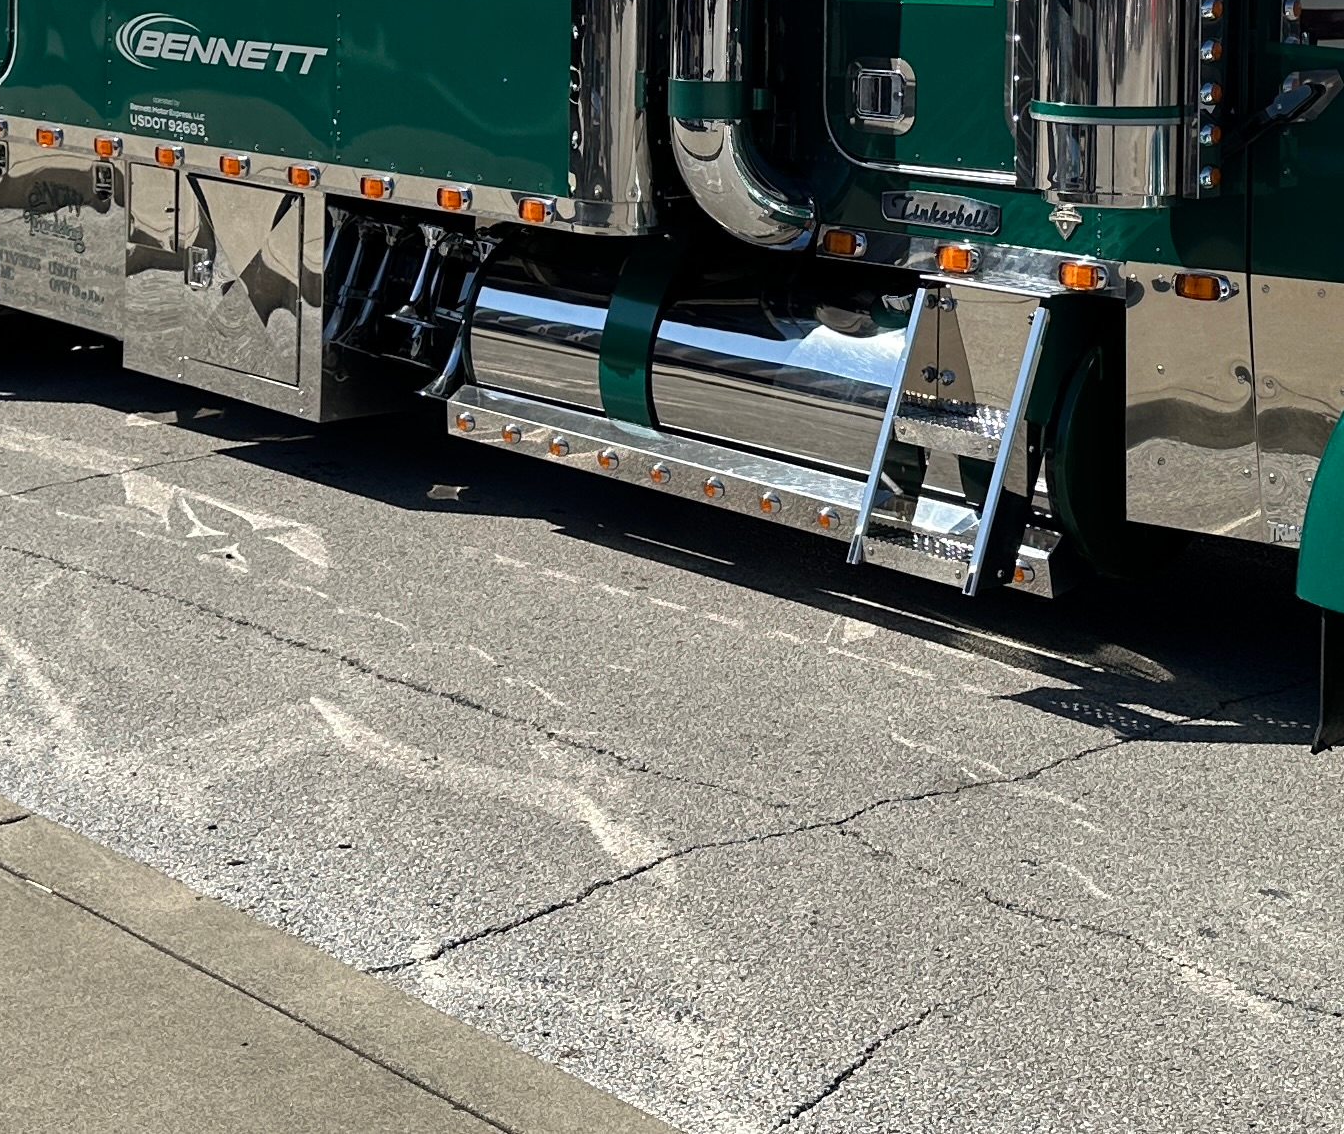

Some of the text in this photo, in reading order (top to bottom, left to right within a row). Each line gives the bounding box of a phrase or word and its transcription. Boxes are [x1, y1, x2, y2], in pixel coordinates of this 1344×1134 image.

[135, 30, 329, 75] BENNETT
[129, 114, 206, 137] USDOT 92693
[891, 194, 989, 229] Tinkerbell
